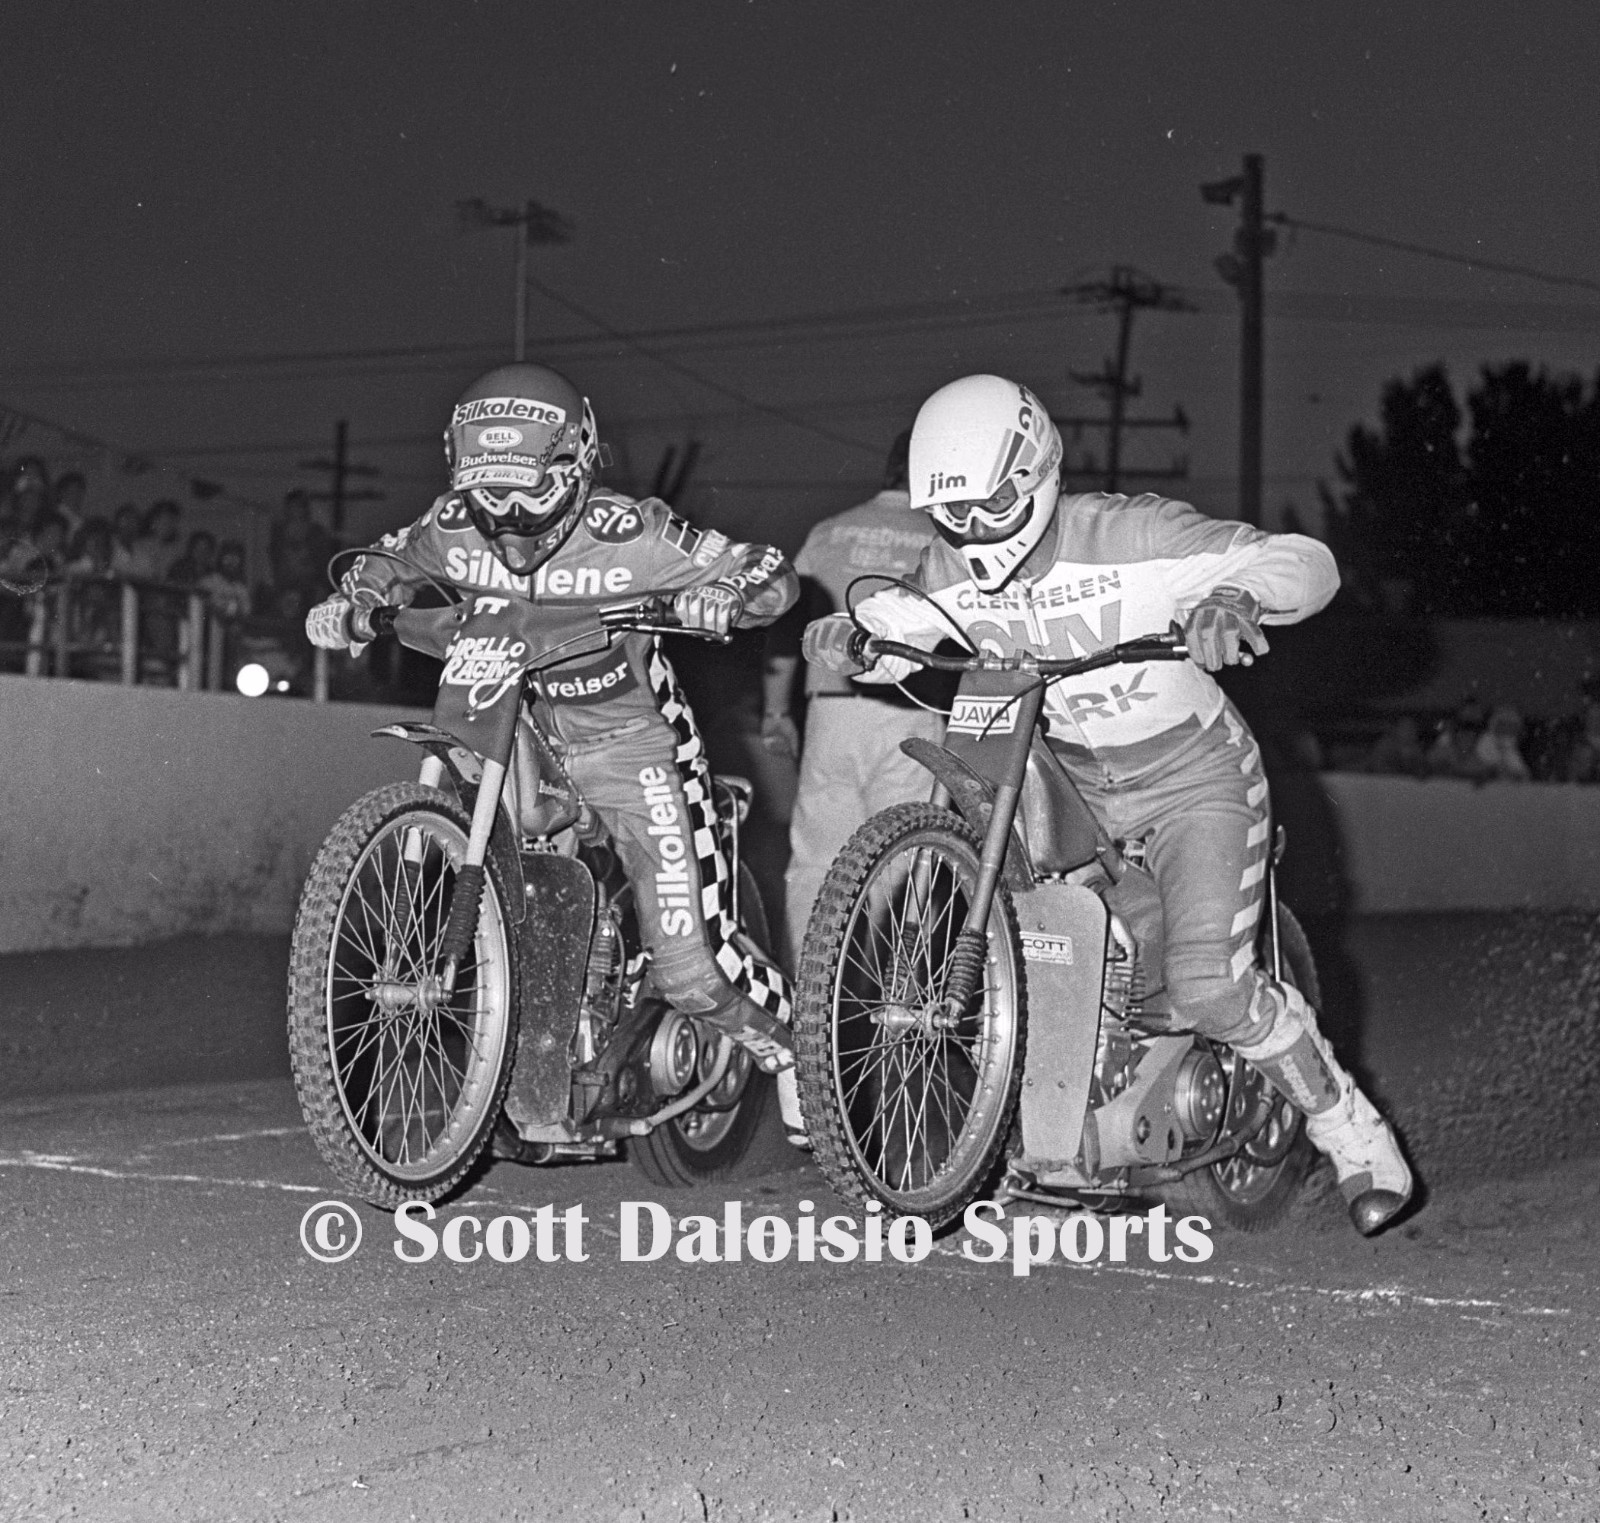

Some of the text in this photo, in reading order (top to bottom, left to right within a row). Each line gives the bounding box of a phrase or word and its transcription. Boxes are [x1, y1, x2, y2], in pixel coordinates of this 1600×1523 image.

[454, 399, 560, 425] Silkolene
[485, 432, 514, 441] BELL
[927, 472, 967, 498] jim
[546, 514, 574, 550] STP
[586, 505, 638, 535] STP
[952, 705, 1011, 724] JAWA
[638, 766, 694, 938] Silkolene
[1020, 938, 1067, 952] COTT
